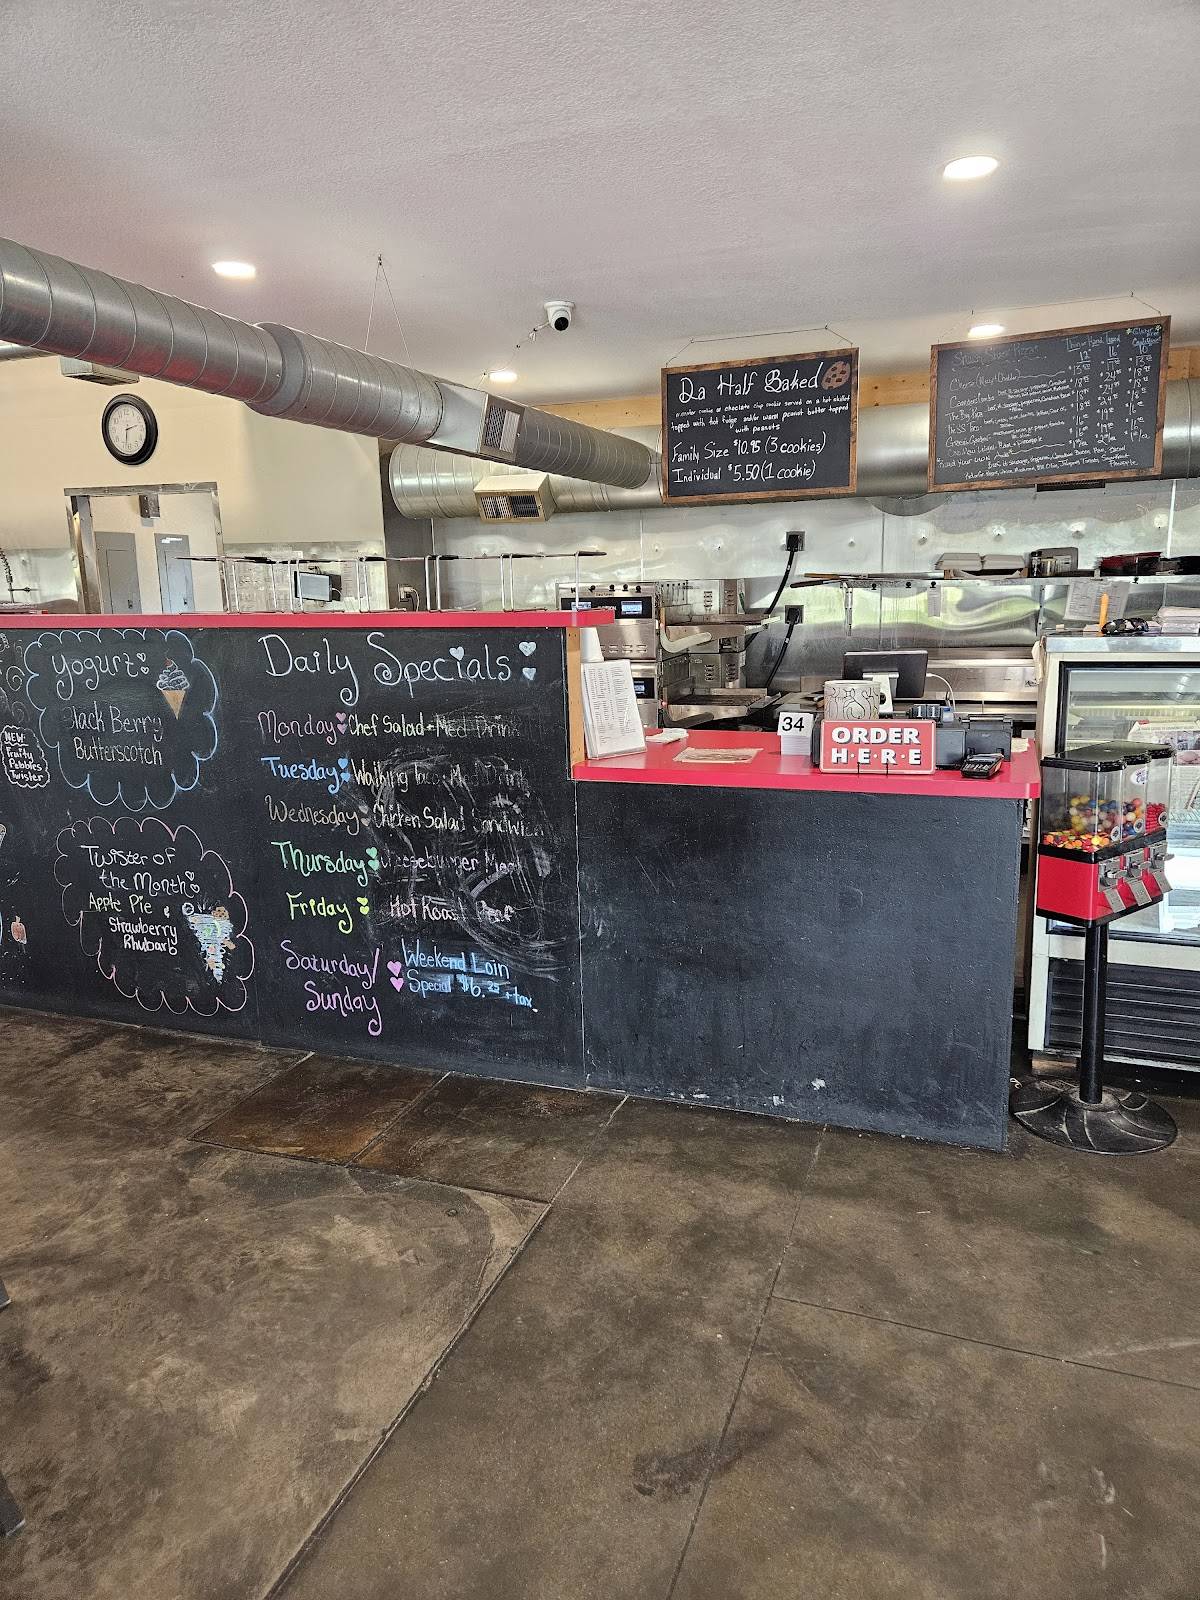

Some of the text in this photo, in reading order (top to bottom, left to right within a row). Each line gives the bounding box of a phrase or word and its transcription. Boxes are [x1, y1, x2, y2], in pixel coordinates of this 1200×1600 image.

[717, 371, 758, 396] Half
[764, 362, 824, 393] Baked
[735, 424, 750, 434] with
[671, 441, 700, 464] Family
[703, 440, 730, 460] Size
[672, 466, 722, 484] Individual
[257, 630, 513, 707] Daily Specials
[109, 704, 165, 743] Berry
[257, 709, 338, 746] Monday
[348, 713, 379, 738] Chef
[382, 711, 425, 738] Salad
[781, 716, 805, 732] 34
[831, 726, 922, 745] ORDER
[6, 747, 34, 763] Fruity
[73, 735, 163, 766] Butterscotch
[10, 769, 44, 783] Twister
[260, 755, 341, 795] Tuesday
[264, 794, 360, 836] Wednesday
[372, 803, 422, 829] Chicken
[423, 805, 466, 833] Salad
[80, 844, 148, 868] Twister
[271, 840, 369, 888] Thursday
[89, 891, 122, 913] Apple
[129, 894, 153, 915] Pie
[285, 891, 354, 935] Friday
[389, 893, 418, 920] Hot
[108, 916, 178, 946] Strawberry
[123, 934, 178, 956] Rhubarb
[401, 937, 467, 972] Weekend
[471, 951, 511, 980] Loin
[303, 979, 383, 1037] Sunday
[406, 968, 453, 999] Special
